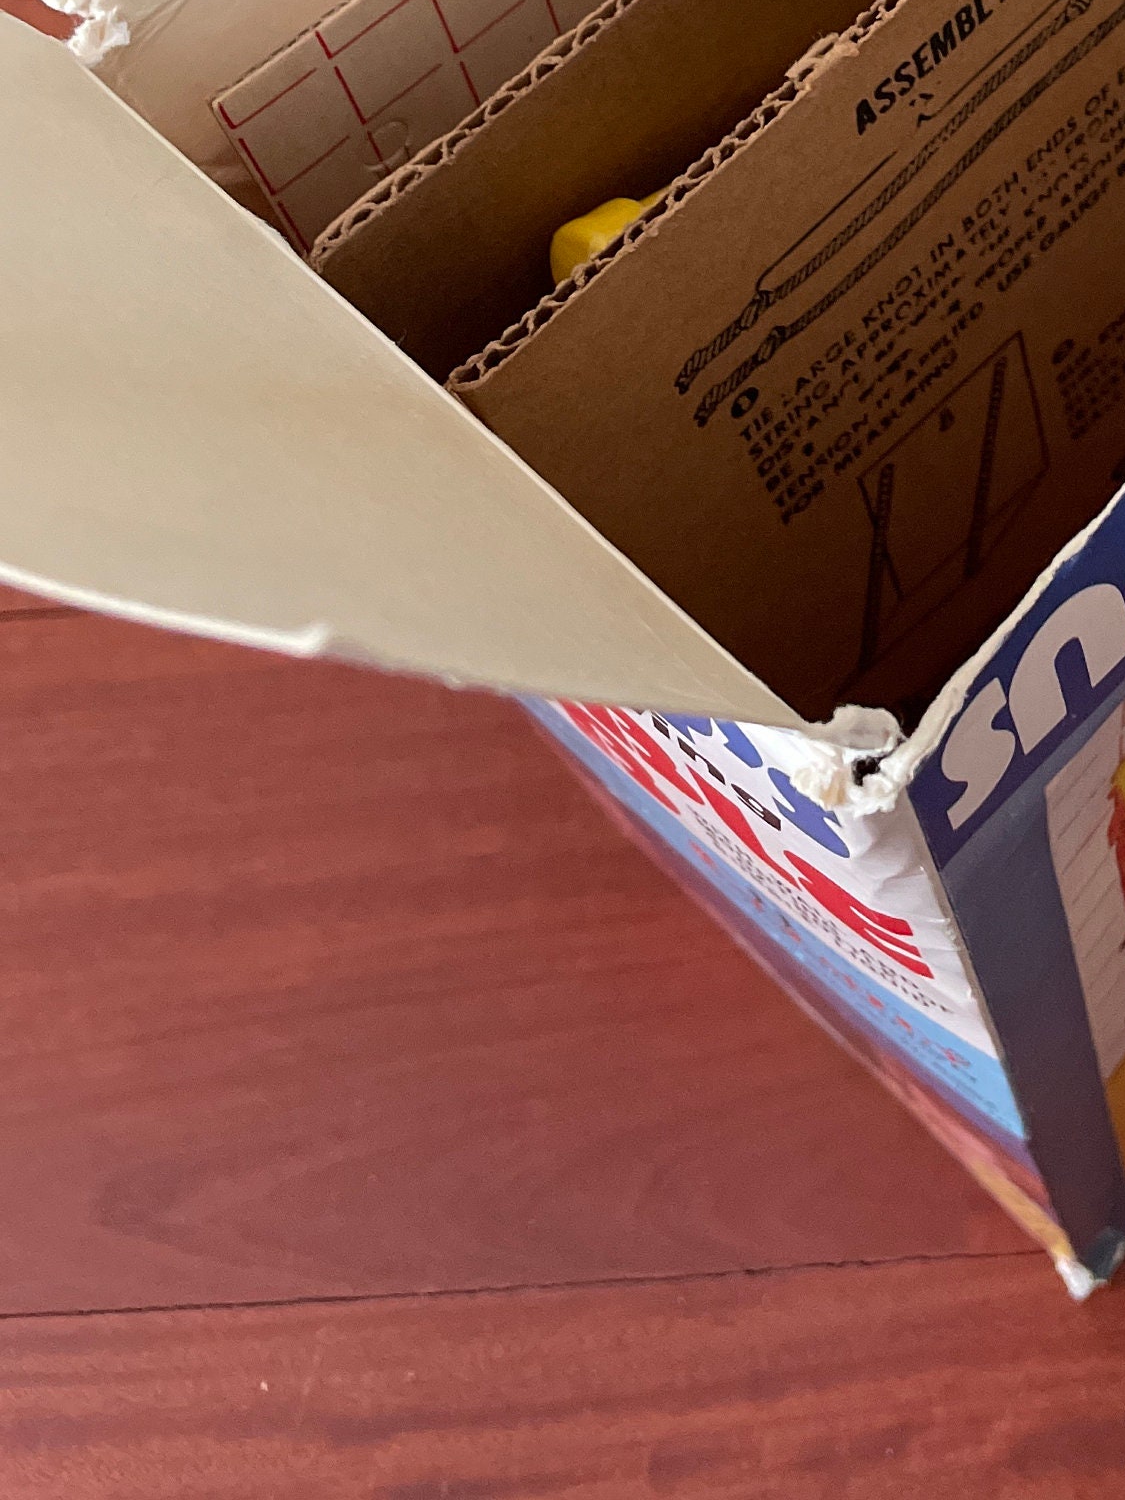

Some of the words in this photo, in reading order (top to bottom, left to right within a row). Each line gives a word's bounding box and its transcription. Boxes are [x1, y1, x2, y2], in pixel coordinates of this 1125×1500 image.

[750, 380, 830, 462] STRING
[1064, 99, 1120, 154] FROM
[861, 266, 923, 328] KNOT
[930, 233, 955, 264] IN
[962, 171, 1019, 234] BOTH
[1026, 115, 1077, 172] ENDS
[1084, 82, 1111, 116] OF
